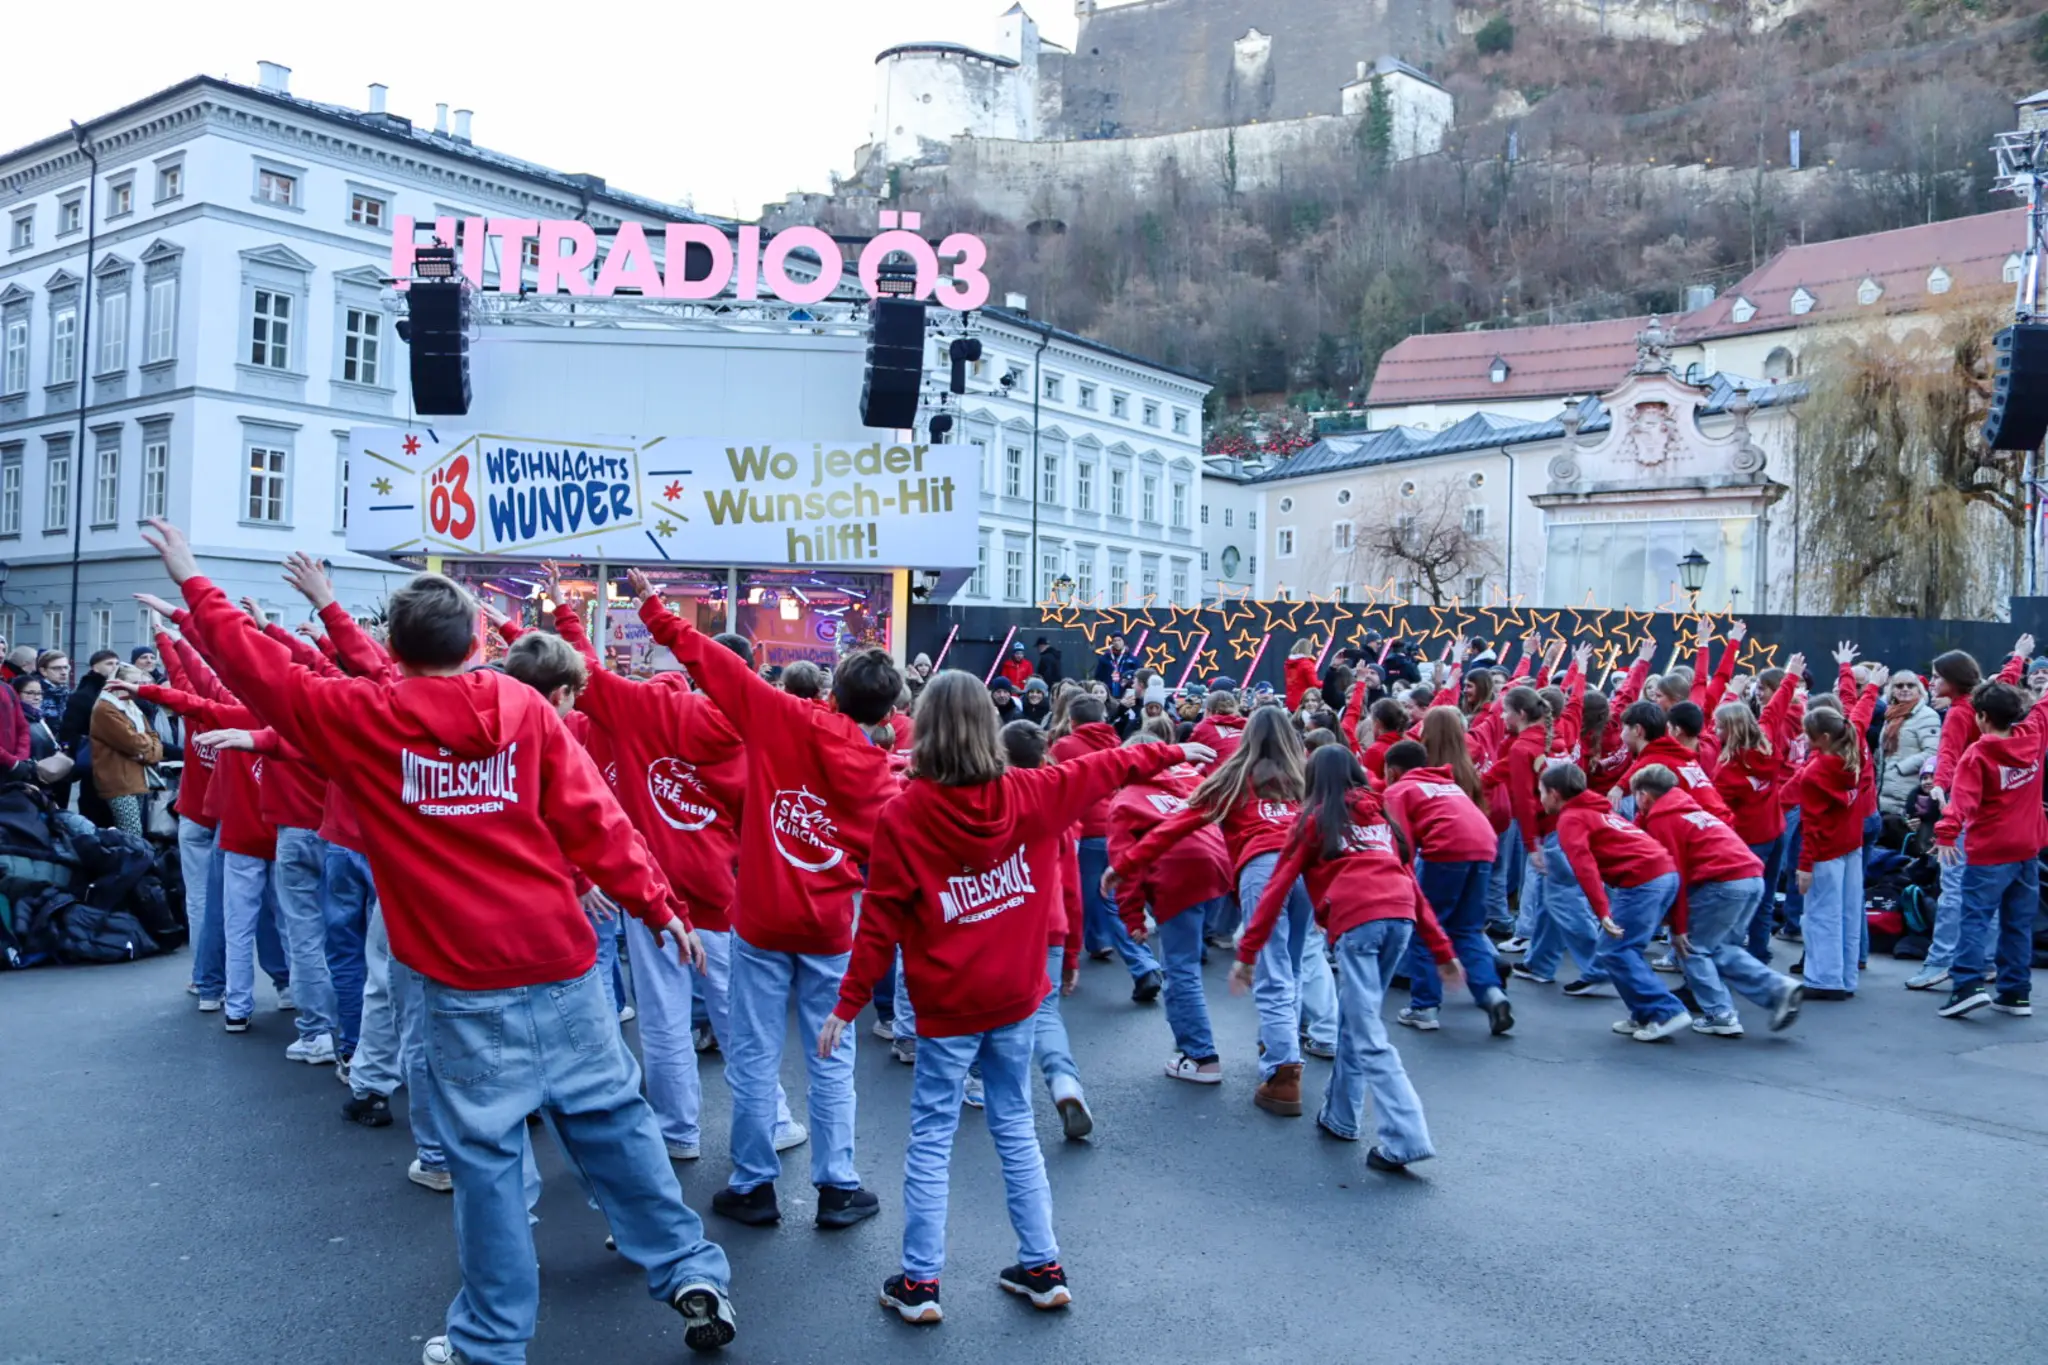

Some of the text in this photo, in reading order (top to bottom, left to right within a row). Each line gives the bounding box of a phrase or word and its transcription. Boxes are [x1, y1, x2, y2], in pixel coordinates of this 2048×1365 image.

[391, 210, 990, 311] HITRADIO Ö3
[486, 447, 630, 484] WEIHNACHTS
[725, 442, 929, 487] Wo jeder
[430, 454, 476, 540] Ö3
[488, 480, 634, 543] WUNDER
[703, 476, 956, 526] Wunsch-Hit
[786, 522, 878, 563] hilft!
[418, 801, 504, 816] SEEKIRCHEN
[957, 895, 1026, 925] SEEKIRCHEN
